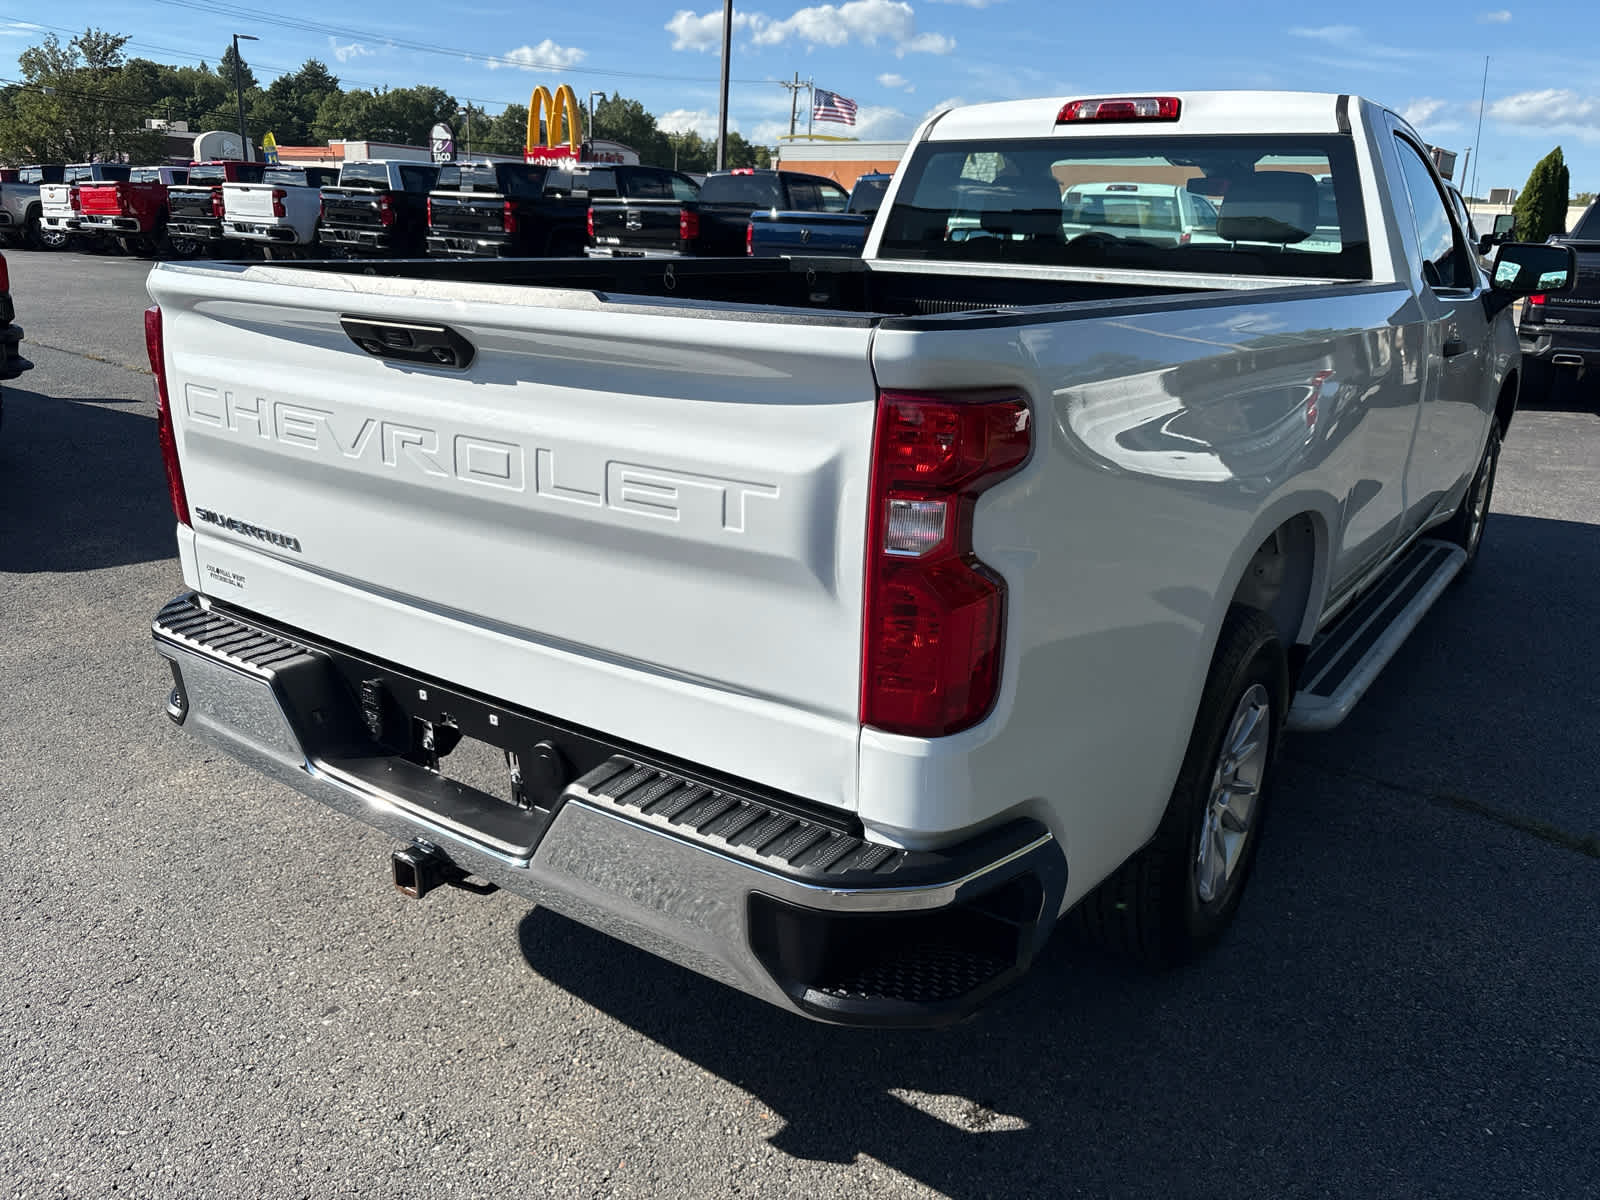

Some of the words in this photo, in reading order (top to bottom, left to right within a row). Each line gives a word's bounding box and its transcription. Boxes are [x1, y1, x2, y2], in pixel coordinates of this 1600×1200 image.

[432, 153, 451, 161] TACO
[184, 382, 781, 534] CHEVROLET
[194, 505, 303, 553] SILVERADO
